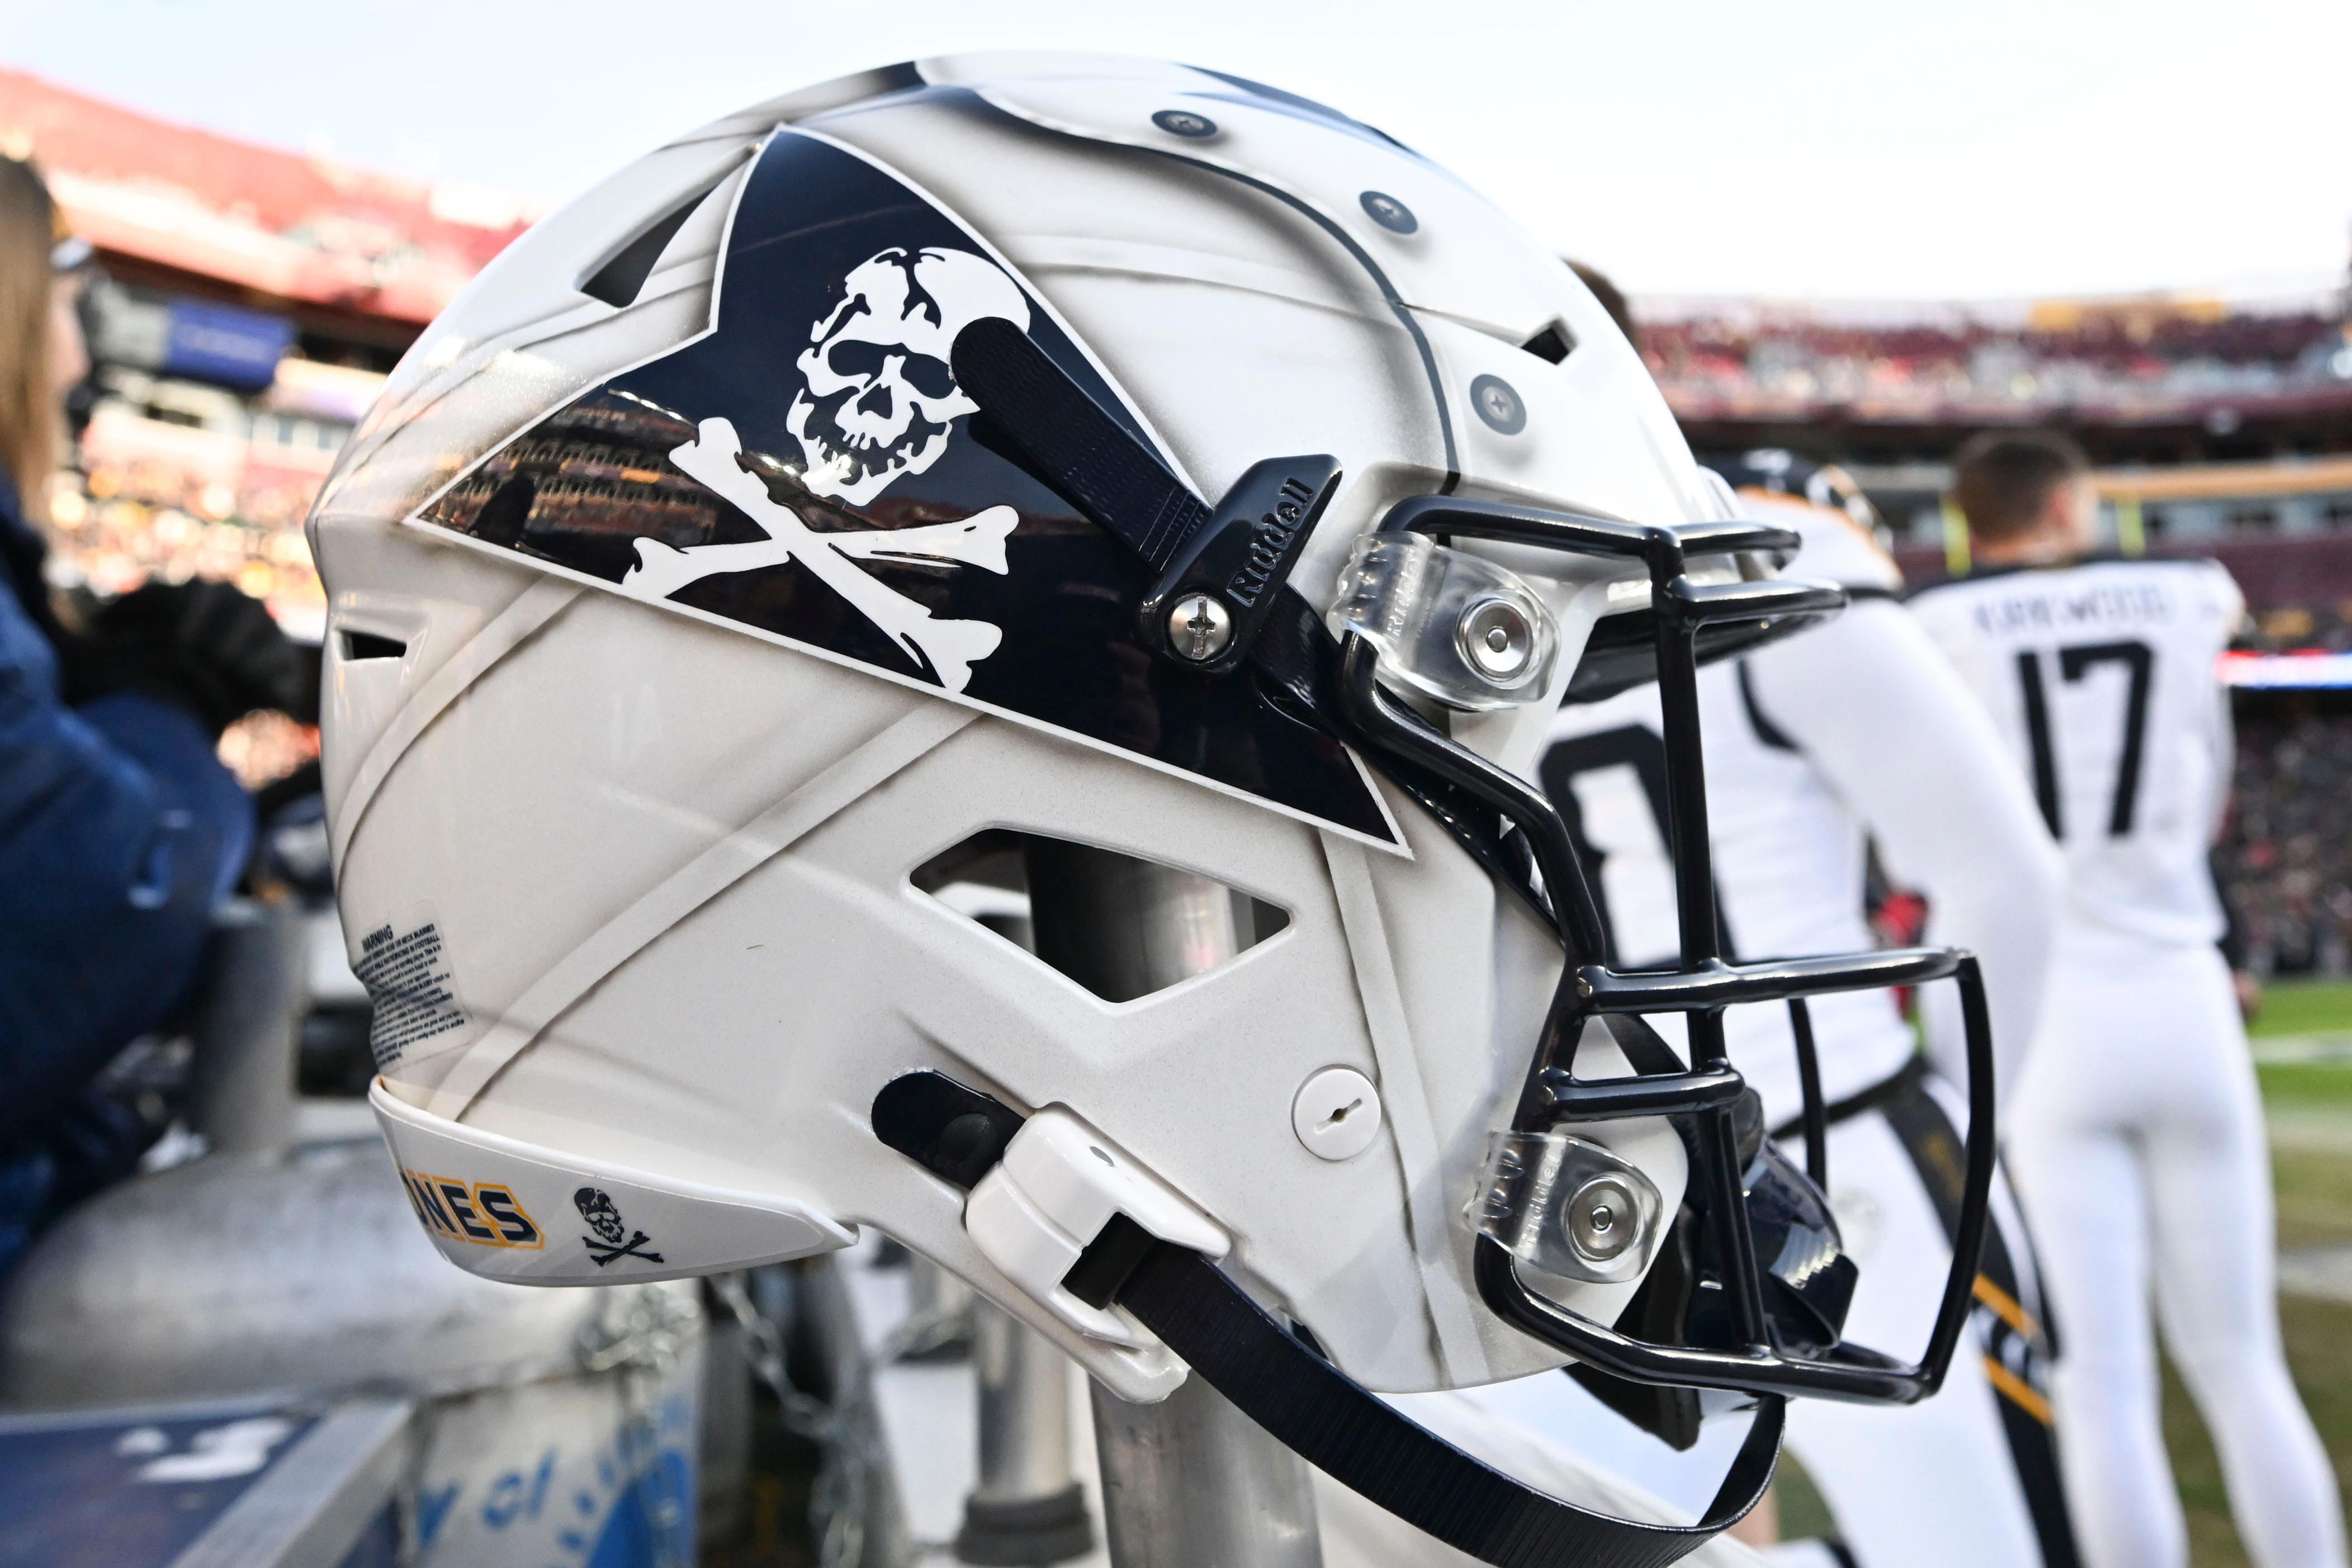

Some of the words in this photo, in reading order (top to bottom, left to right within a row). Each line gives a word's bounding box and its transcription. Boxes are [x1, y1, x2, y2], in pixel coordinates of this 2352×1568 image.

[1226, 477, 1313, 607] Riddell
[2014, 639, 2154, 845] 17
[361, 924, 394, 953] WARNING
[414, 933, 440, 951] FOOTBALL
[398, 1166, 545, 1250] NES
